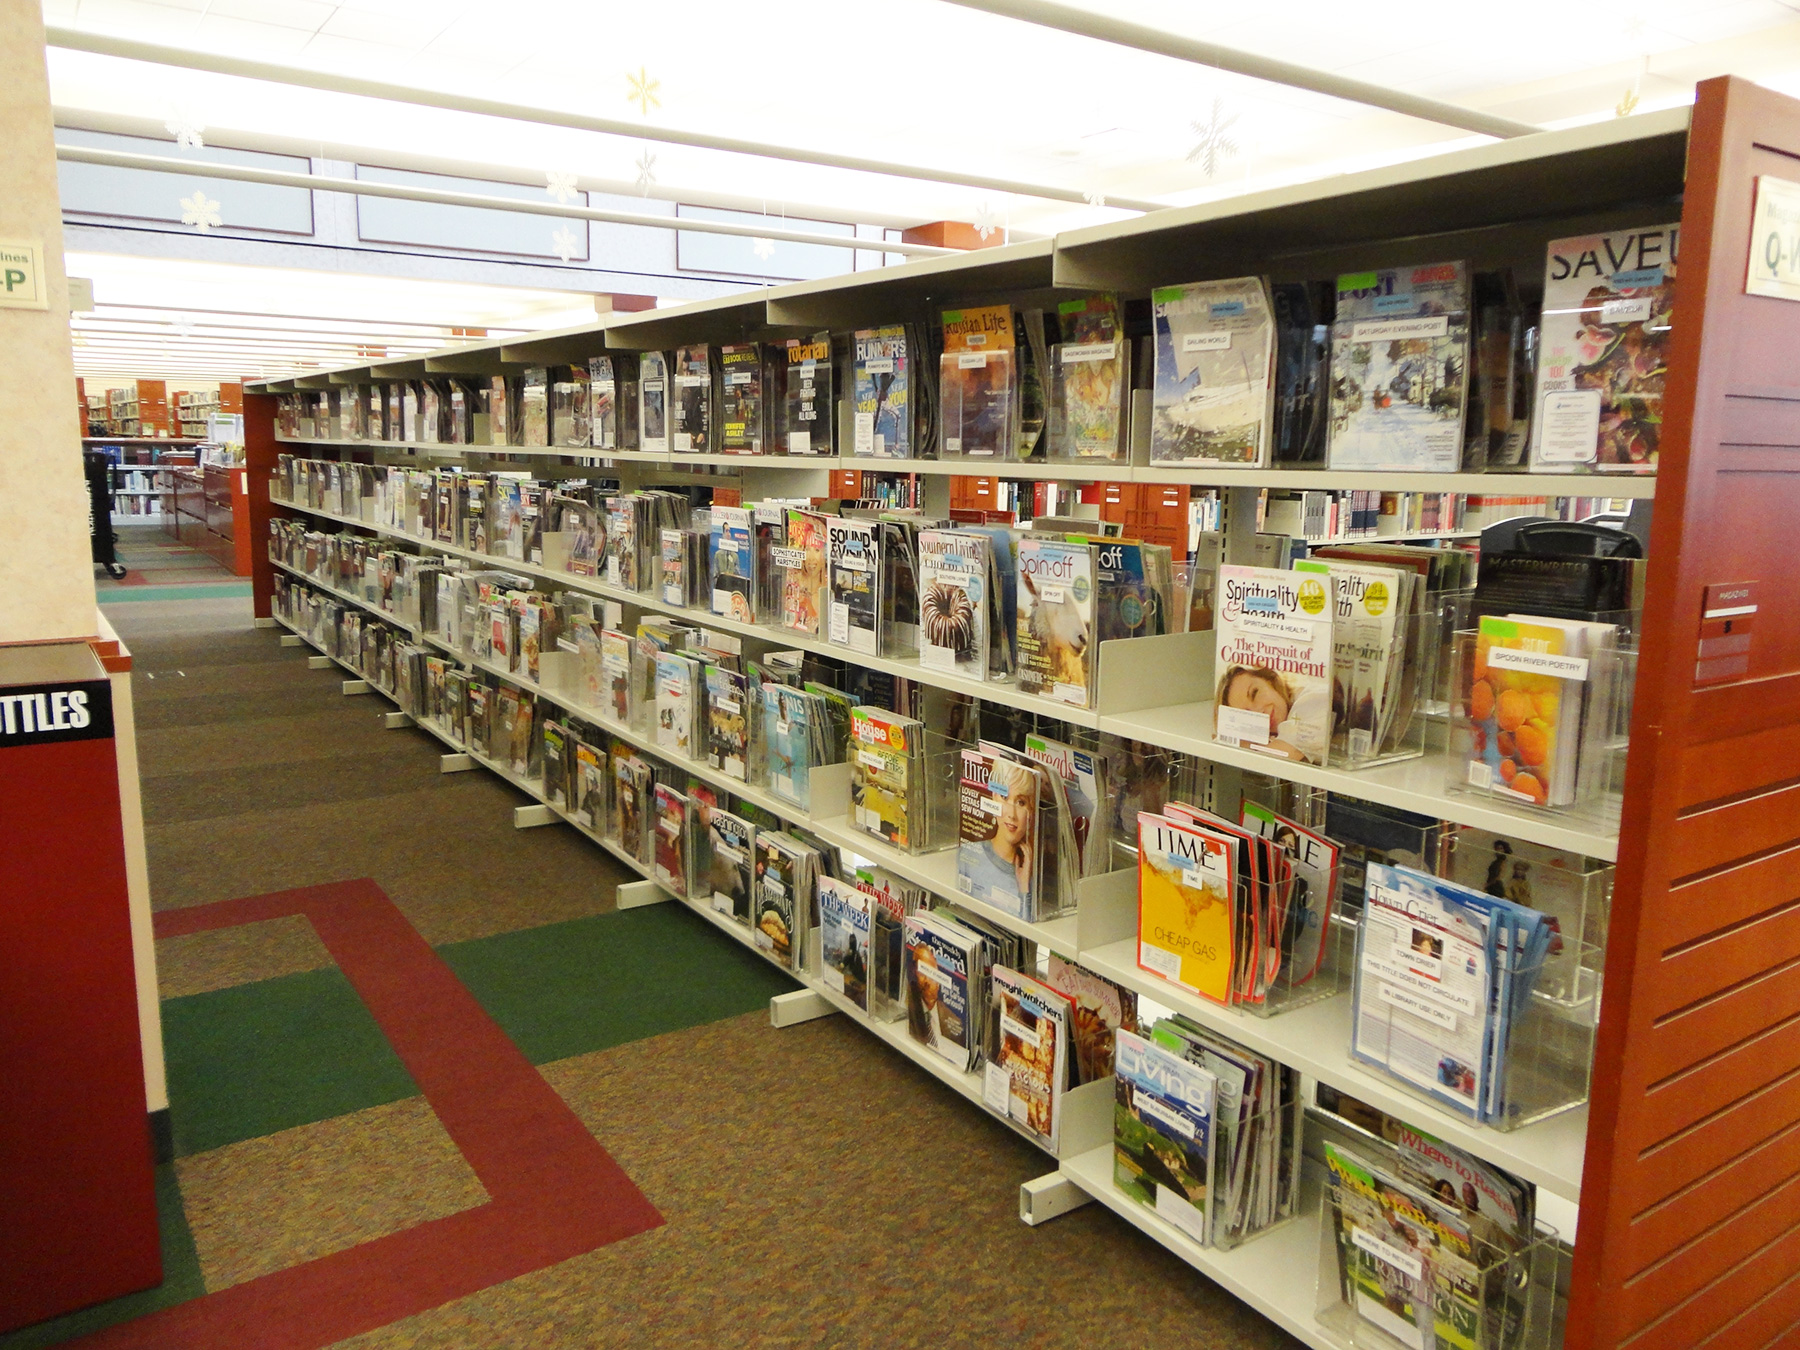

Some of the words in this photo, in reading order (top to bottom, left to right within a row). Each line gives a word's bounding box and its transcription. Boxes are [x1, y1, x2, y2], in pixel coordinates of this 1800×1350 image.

[983, 313, 1007, 334] Life
[1358, 327, 1392, 336] SATURDAY
[1393, 324, 1421, 333] EVENING
[1423, 321, 1442, 331] POST
[1187, 337, 1208, 346] SAILING
[1209, 335, 1227, 344] WORLD
[788, 342, 828, 363] rotarian
[830, 527, 871, 548] SOUND
[1226, 578, 1299, 613] Spirituality
[1244, 619, 1280, 630] SPIRITUALITY
[1285, 626, 1308, 635] HEALTH
[1235, 638, 1255, 651] The
[1256, 641, 1298, 660] Pursuit
[1301, 646, 1314, 661] of
[1221, 645, 1326, 679] Contentment
[1495, 652, 1521, 663] SPOON
[1523, 656, 1548, 666] RIVER
[1548, 659, 1581, 672] POETRY
[853, 716, 887, 741] House
[961, 786, 979, 798] LOVELY
[961, 795, 980, 808] DETAILS
[961, 803, 972, 814] SEW
[972, 808, 985, 818] NOW
[1157, 827, 1216, 871] TIME
[1187, 874, 1199, 883] TIME
[822, 893, 844, 914] THE
[844, 904, 869, 932] WEEK
[878, 891, 904, 919] WEEK
[1371, 884, 1403, 911] Town
[1405, 899, 1439, 926] Crier
[1154, 926, 1191, 949] CHEAP
[1192, 941, 1217, 962] GAS
[1396, 949, 1416, 961] TOWN
[1367, 960, 1382, 972] THIS
[1382, 964, 1398, 977] TITLE
[1399, 971, 1416, 985] DOES
[1418, 978, 1431, 990] NOT
[1432, 984, 1470, 1008] CIRCULATE
[1384, 989, 1390, 997] IN
[1390, 991, 1417, 1009] LIBRARY
[1418, 1003, 1432, 1015] USE
[1433, 1008, 1452, 1022] ONLY
[1400, 1128, 1453, 1170] Where
[1454, 1160, 1473, 1182] to
